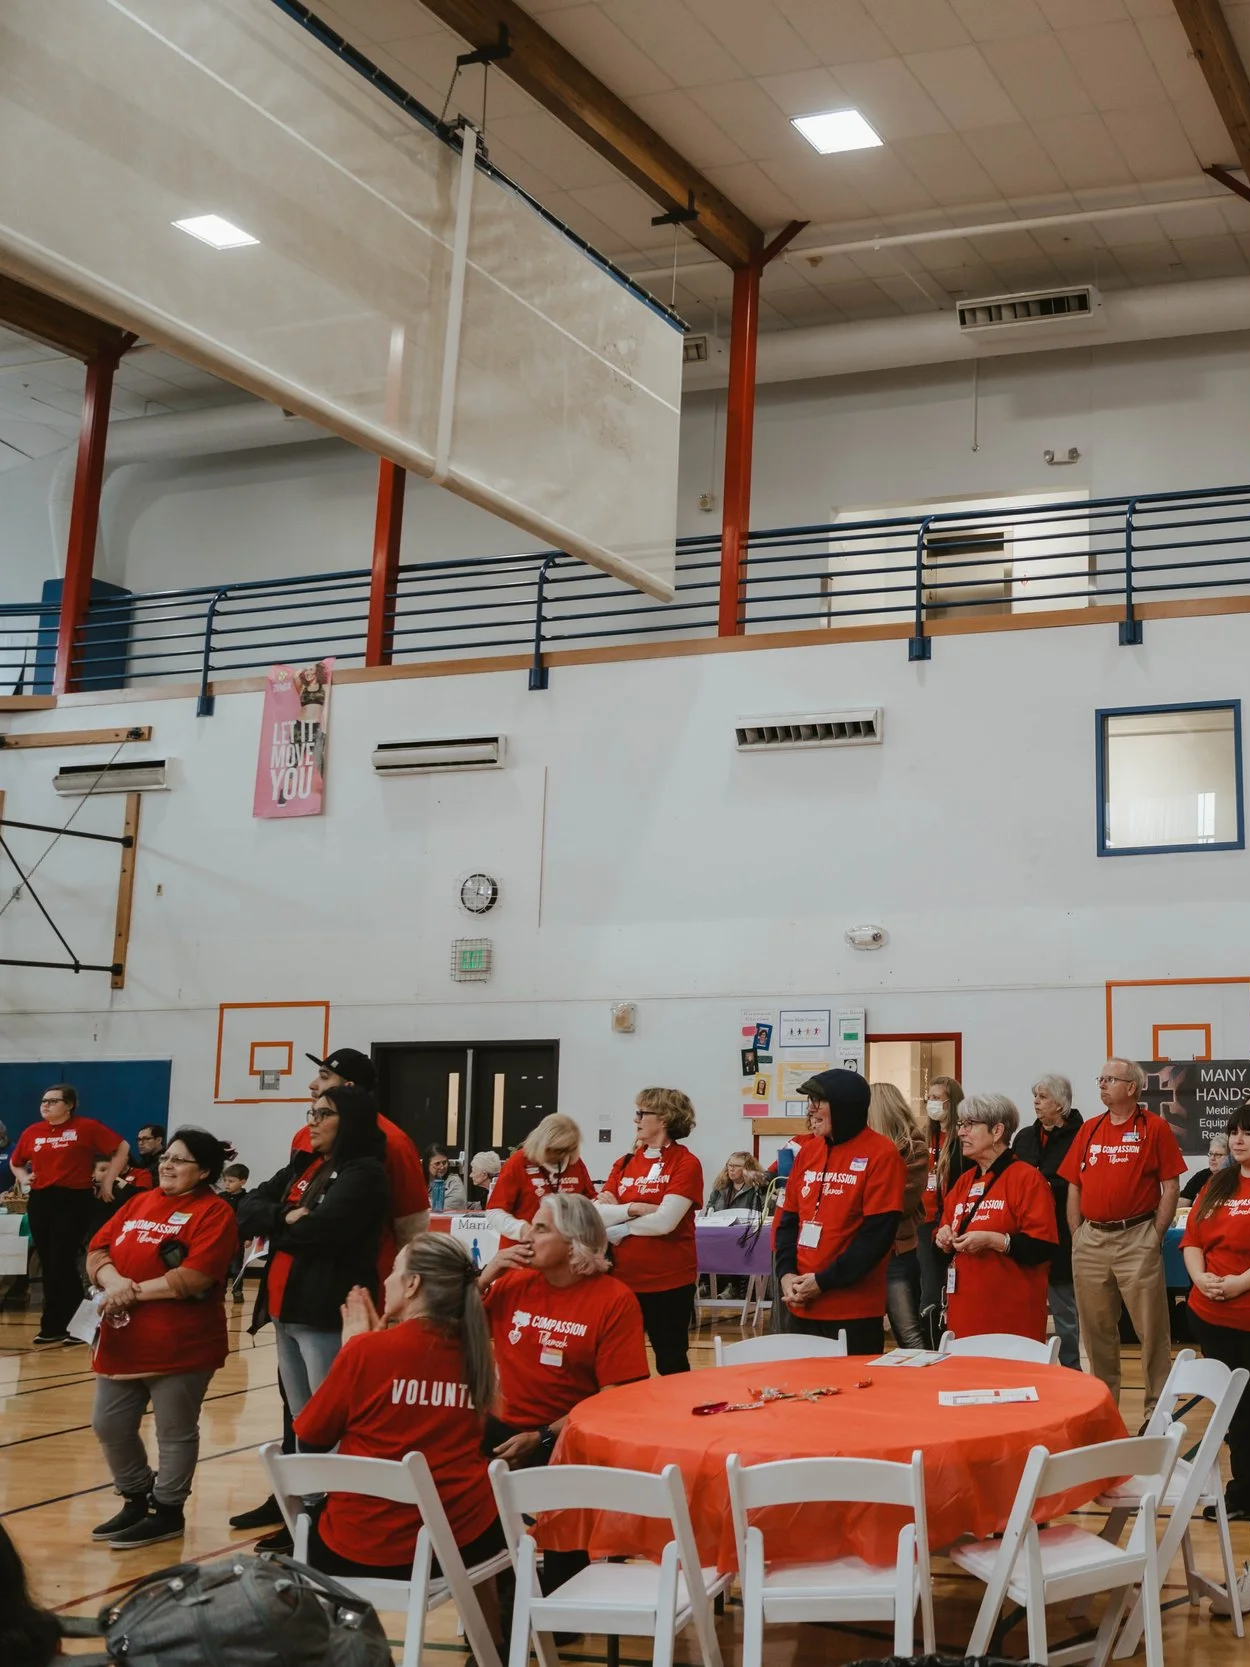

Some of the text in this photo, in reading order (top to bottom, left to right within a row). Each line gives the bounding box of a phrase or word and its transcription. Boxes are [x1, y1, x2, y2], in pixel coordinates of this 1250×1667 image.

[272, 719, 315, 745] LET IT
[270, 742, 315, 769] MOVE
[270, 766, 314, 801] YOU
[1200, 1068, 1248, 1082] MANY
[1102, 1145, 1140, 1154] COMPASSION
[531, 1315, 588, 1337] COMPASSION
